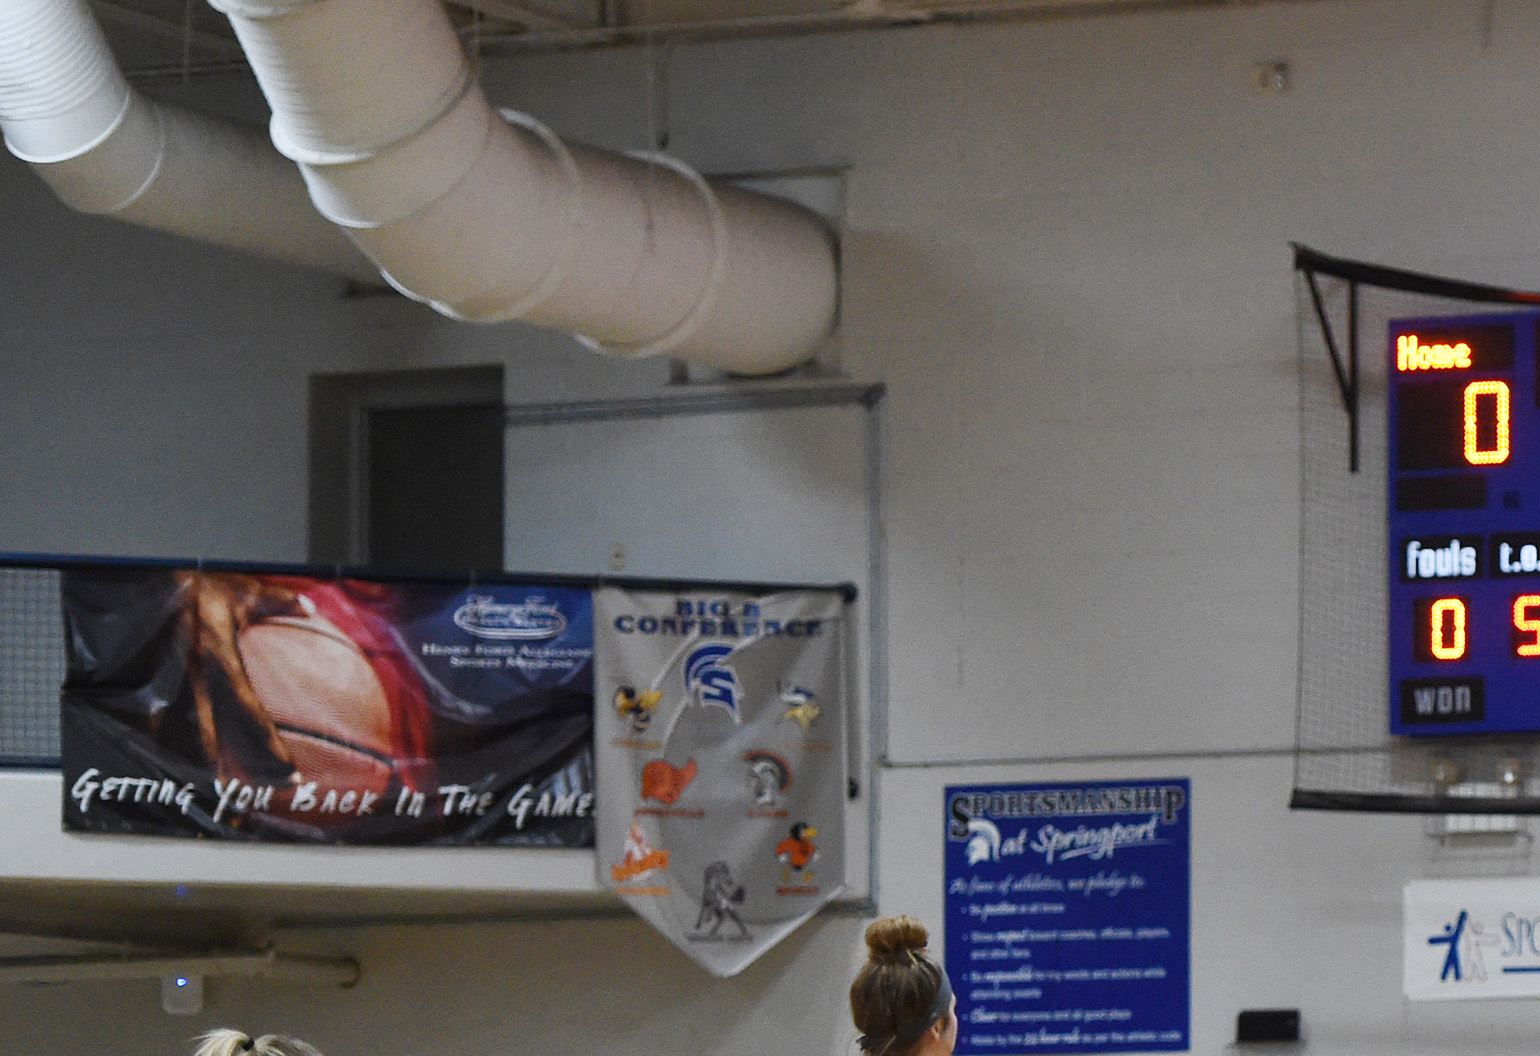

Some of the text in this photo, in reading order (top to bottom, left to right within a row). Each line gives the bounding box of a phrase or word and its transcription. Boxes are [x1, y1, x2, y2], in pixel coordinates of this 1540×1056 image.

[1397, 335, 1472, 372] Home
[1463, 380, 1512, 466] 0
[1405, 541, 1477, 579] fouls
[1430, 597, 1467, 661] 0
[1413, 681, 1473, 714] won
[950, 786, 1185, 840] SPORTSMANSHIP
[1001, 813, 1158, 865] at Springport
